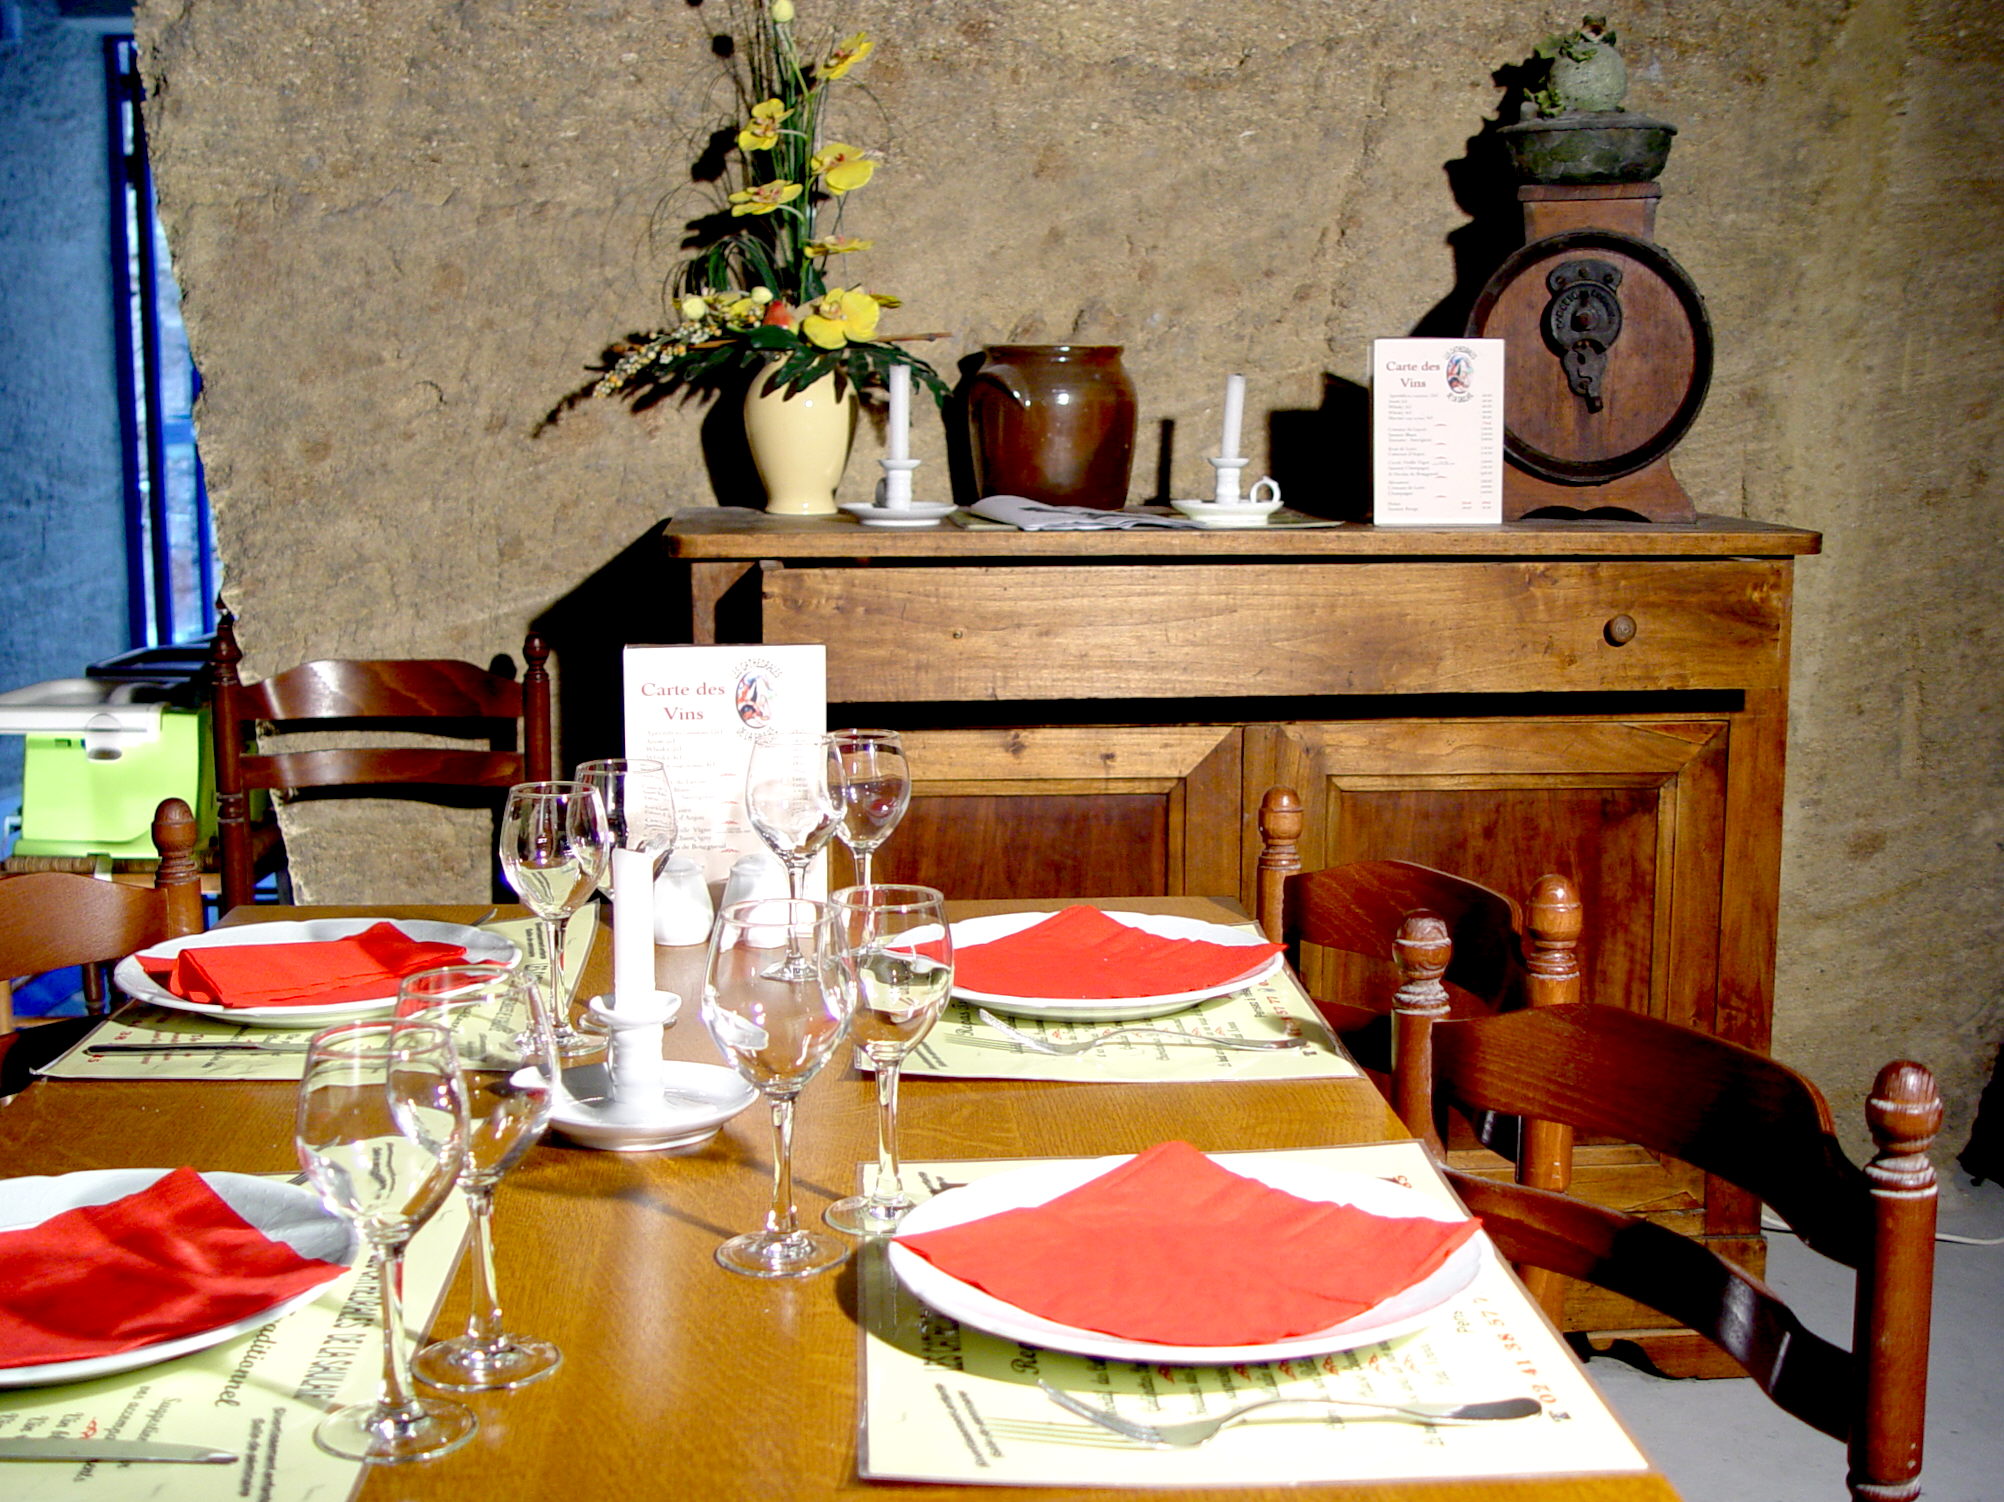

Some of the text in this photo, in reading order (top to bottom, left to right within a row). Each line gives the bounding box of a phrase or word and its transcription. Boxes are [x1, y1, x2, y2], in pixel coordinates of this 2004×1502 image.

[1386, 360, 1441, 372] Carte des
[1400, 378, 1427, 389] Vins
[641, 682, 726, 697] Carte des
[663, 707, 704, 721] Vins
[322, 1333, 367, 1343] DE
[314, 1347, 359, 1357] LA
[212, 1321, 280, 1407] aditionnel
[1514, 1359, 1539, 1375] 41
[1531, 1384, 1558, 1404] 02
